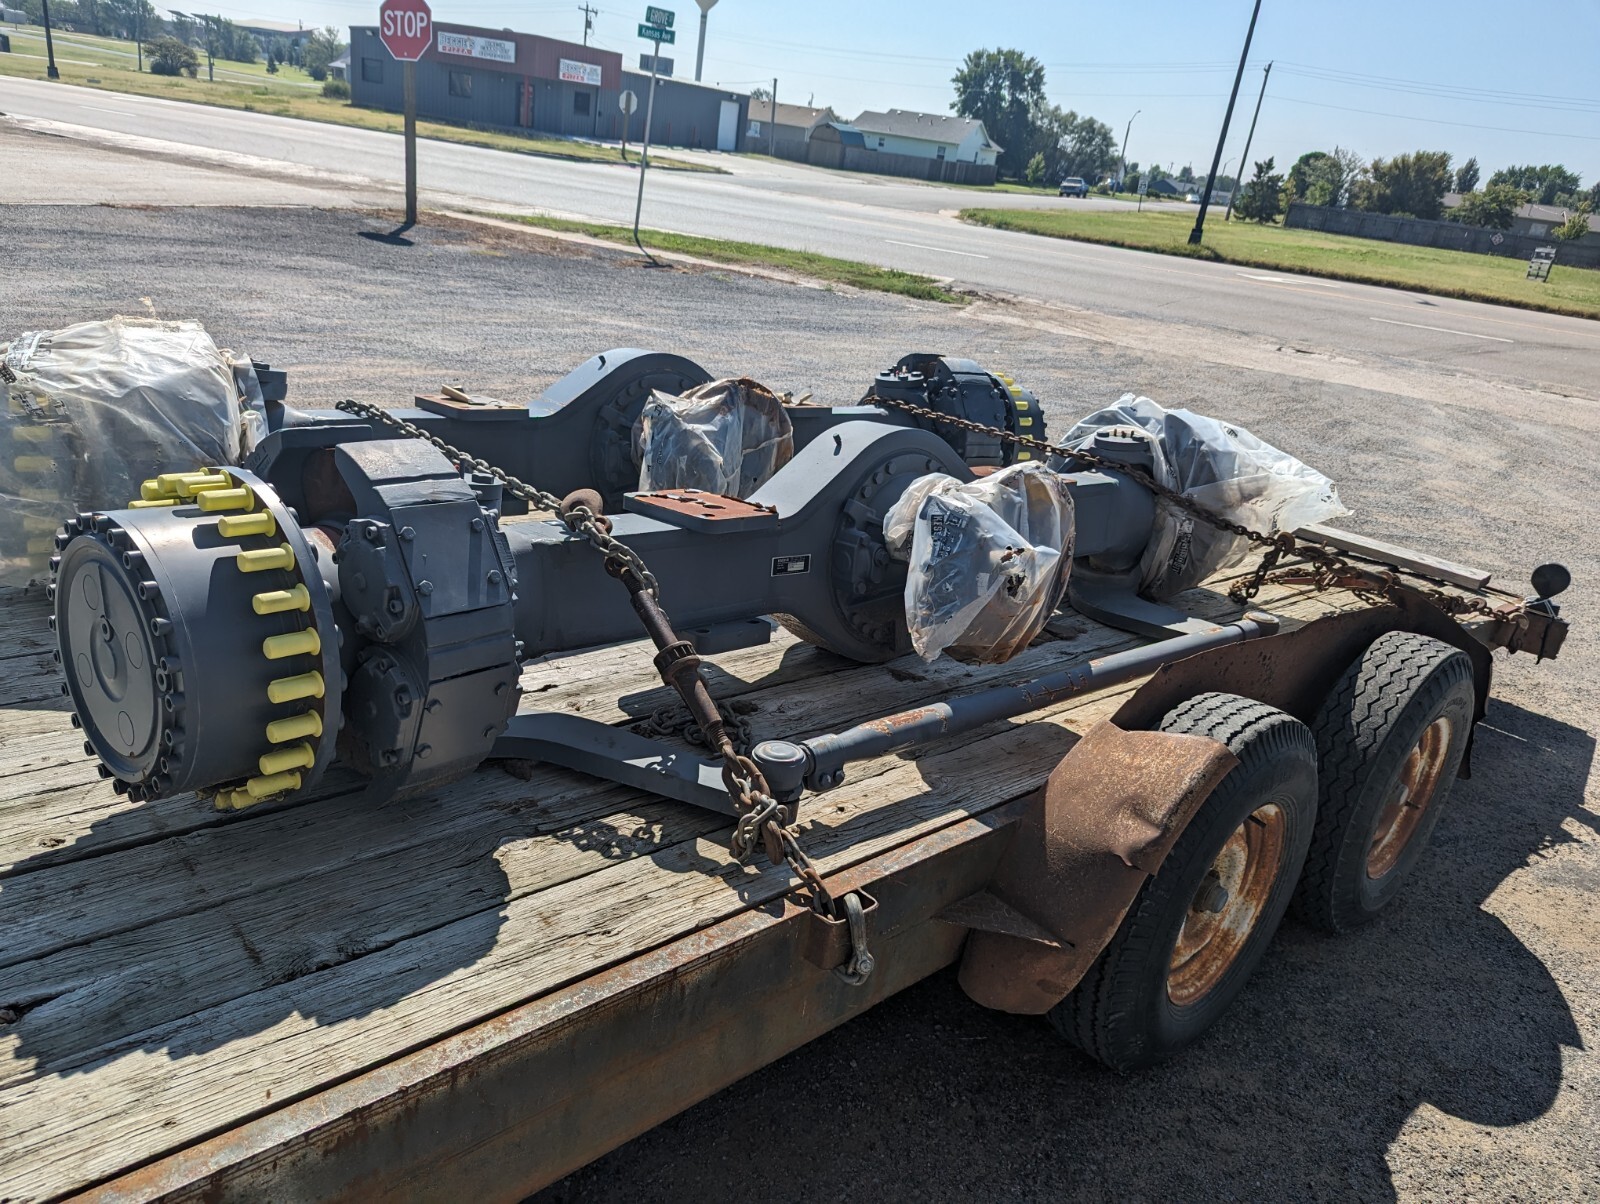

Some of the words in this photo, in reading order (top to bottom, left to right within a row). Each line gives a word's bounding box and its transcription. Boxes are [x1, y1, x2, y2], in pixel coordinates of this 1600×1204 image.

[383, 9, 428, 38] STOP
[650, 8, 668, 26] GROVE
[641, 27, 660, 39] Kansas
[661, 30, 671, 41] Ave
